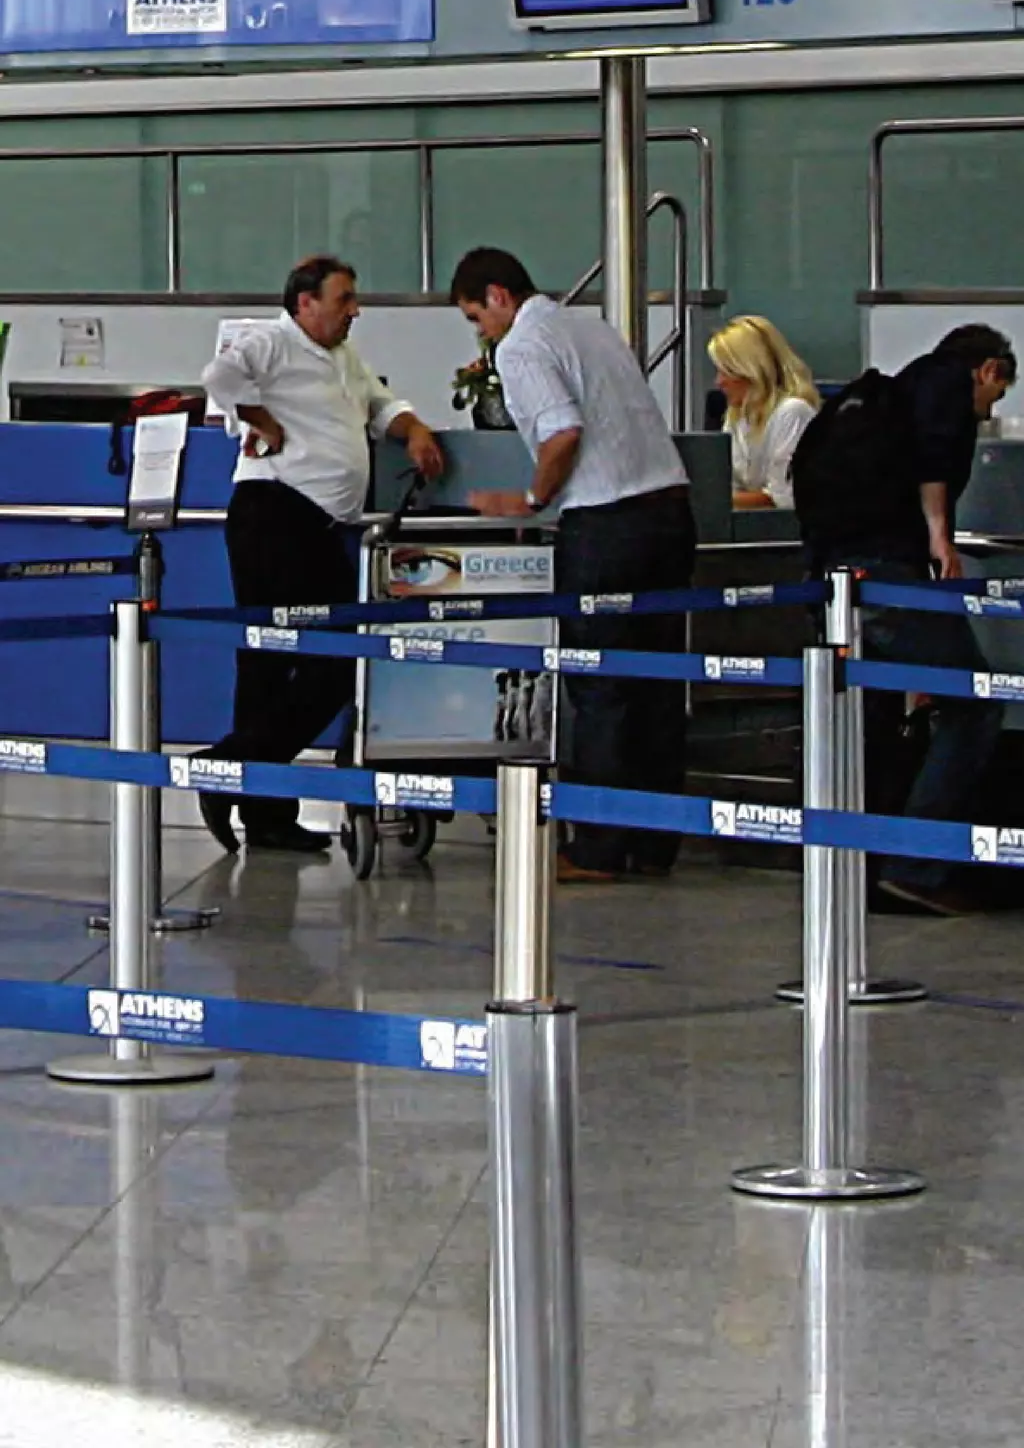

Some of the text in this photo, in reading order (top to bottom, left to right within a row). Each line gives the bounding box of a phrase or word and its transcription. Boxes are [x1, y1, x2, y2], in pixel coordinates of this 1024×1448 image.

[465, 554, 549, 573] Greece
[191, 759, 242, 776] ATHENS
[398, 774, 453, 791] ATHENS
[736, 804, 802, 824] ATHENS
[121, 993, 203, 1022] ATHENS
